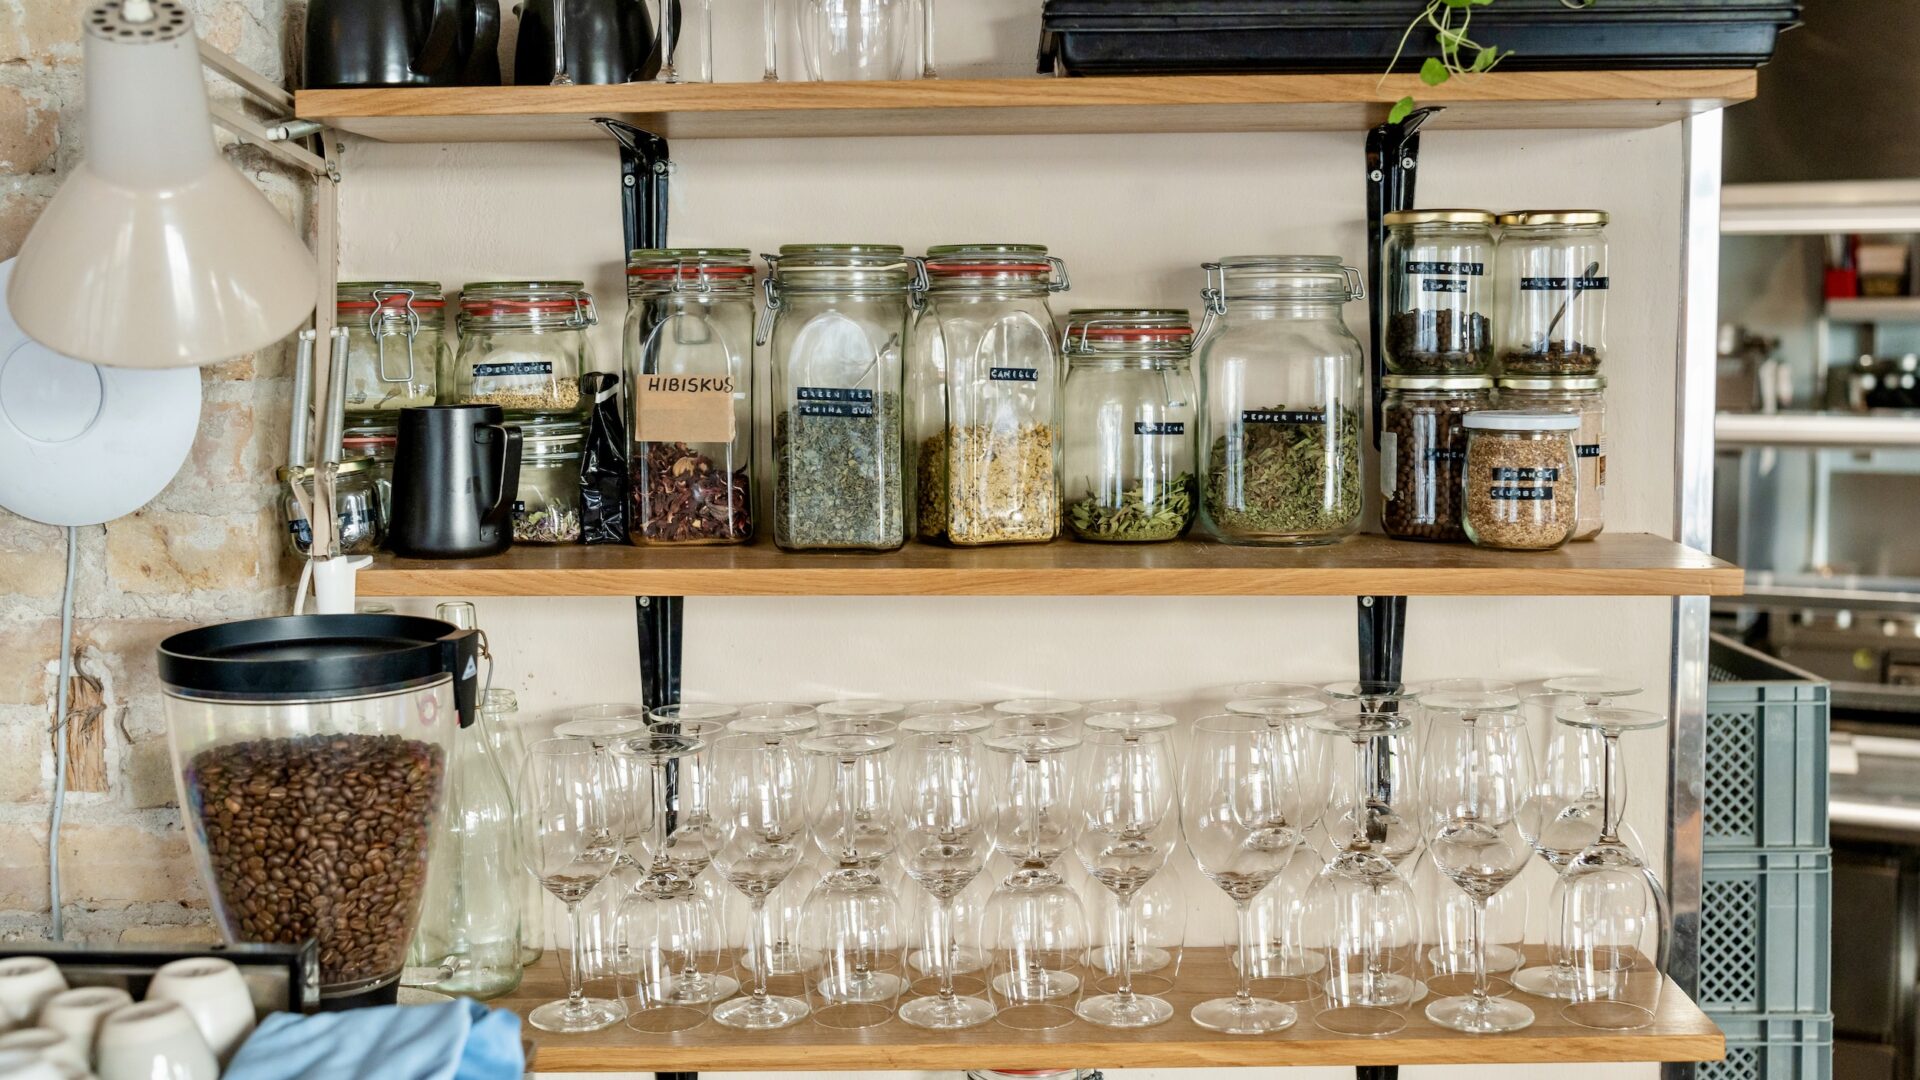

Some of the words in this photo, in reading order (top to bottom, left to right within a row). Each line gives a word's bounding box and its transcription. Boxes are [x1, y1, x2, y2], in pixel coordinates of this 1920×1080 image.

[648, 377, 734, 393] HIBISKUS
[801, 389, 840, 399] GREEN
[850, 391, 872, 399] TEA
[1242, 413, 1287, 422] PEPPER
